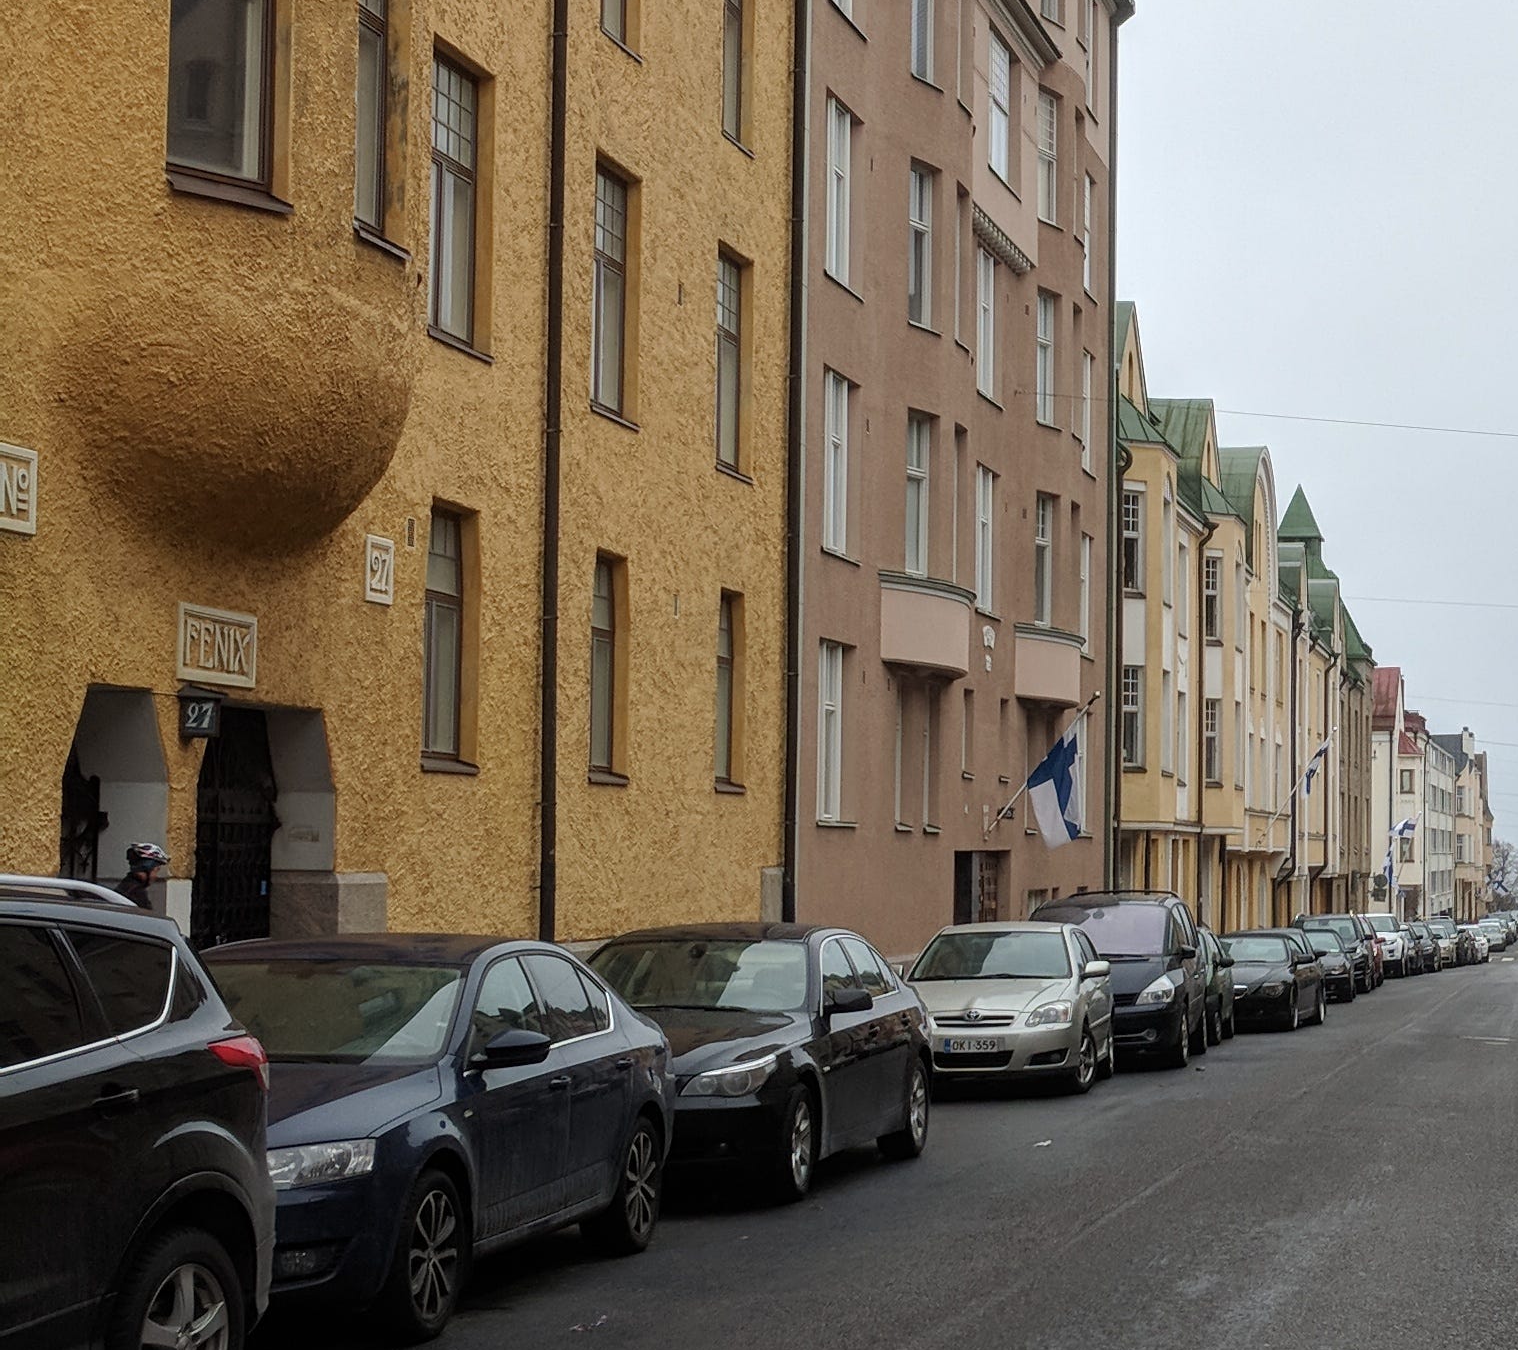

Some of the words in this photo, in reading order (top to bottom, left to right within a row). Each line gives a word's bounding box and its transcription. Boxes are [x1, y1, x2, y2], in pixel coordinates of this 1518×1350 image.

[371, 552, 389, 592] 27
[185, 616, 252, 675] FENIX
[185, 702, 214, 728] 27
